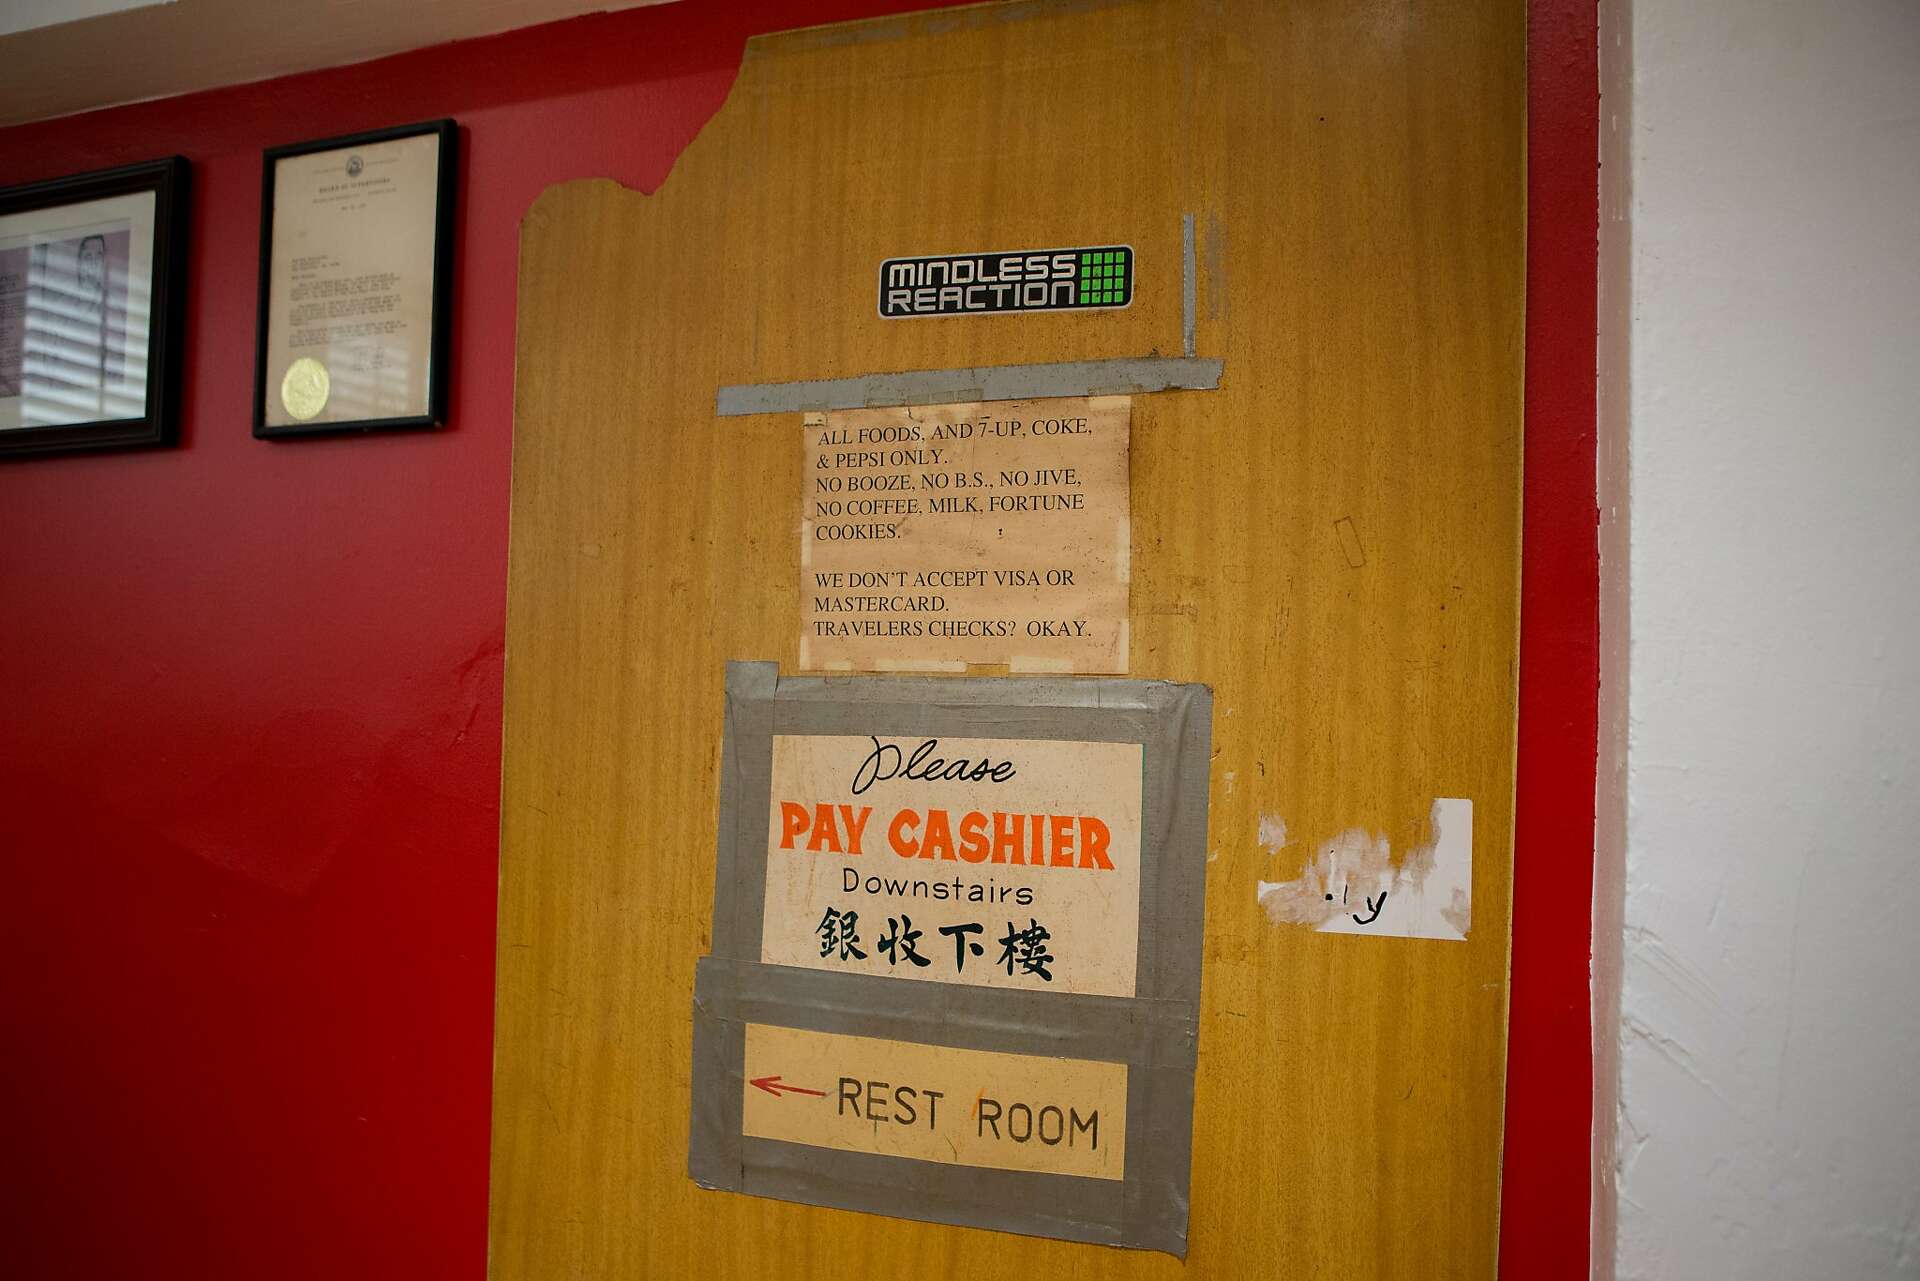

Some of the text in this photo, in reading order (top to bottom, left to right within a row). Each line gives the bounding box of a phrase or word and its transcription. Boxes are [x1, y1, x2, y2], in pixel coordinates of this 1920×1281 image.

[888, 254, 1077, 288] MINDLESS
[887, 281, 1076, 313] REACTION
[818, 430, 853, 445] ALL
[931, 422, 973, 440] AND
[978, 421, 1026, 439] 7-UP,
[1032, 418, 1092, 435] COKE,
[817, 447, 947, 469] & PEPSI ONLY.
[816, 469, 1081, 494] NO BOOZE, NO B.S., NO JIVE,
[817, 501, 841, 517] NO
[928, 497, 983, 516] MILK,
[989, 494, 1084, 512] FORTUNE
[816, 524, 901, 540] COOKIES.
[815, 573, 843, 589] WE
[912, 569, 988, 587] ACCEPT
[992, 568, 1040, 586] VISA
[1047, 569, 1075, 586] OR
[815, 595, 948, 614] MASTERCARD.
[814, 621, 1091, 638] TRAVELERS CHECKS? OKAY.
[779, 801, 1116, 871] PAY CASHIER
[843, 868, 1034, 905] Downstairs
[815, 906, 1056, 982] 銀收下樓
[838, 1077, 1099, 1151] REST ROOM
